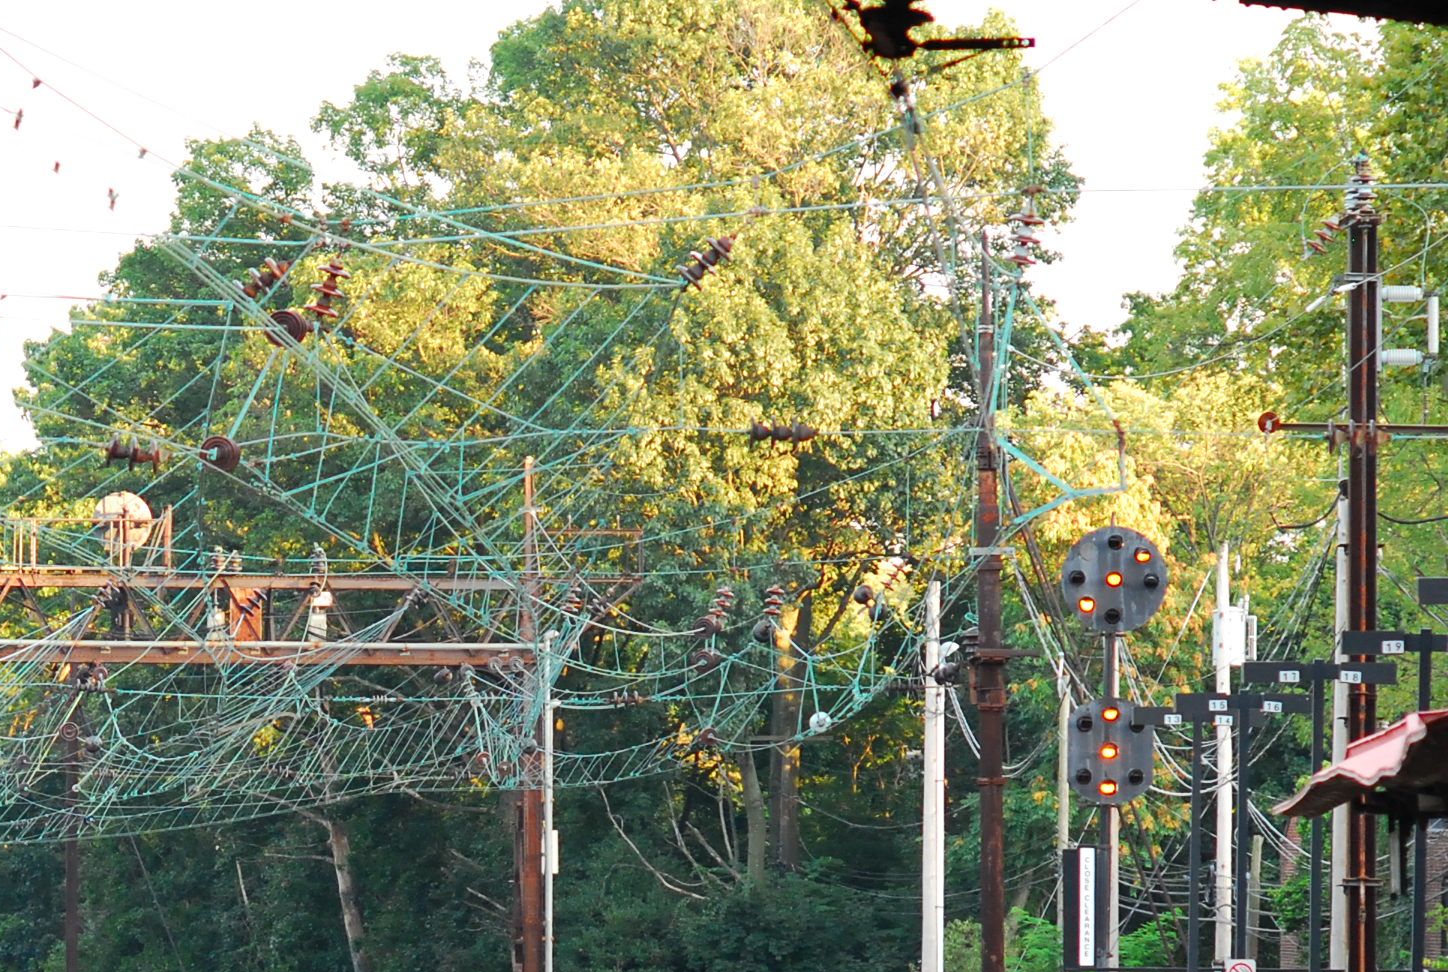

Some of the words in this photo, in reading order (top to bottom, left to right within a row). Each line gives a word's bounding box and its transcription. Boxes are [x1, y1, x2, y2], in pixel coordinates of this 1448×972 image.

[1386, 642, 1402, 652] 19
[1344, 672, 1359, 681] 18
[1211, 701, 1226, 709] 15
